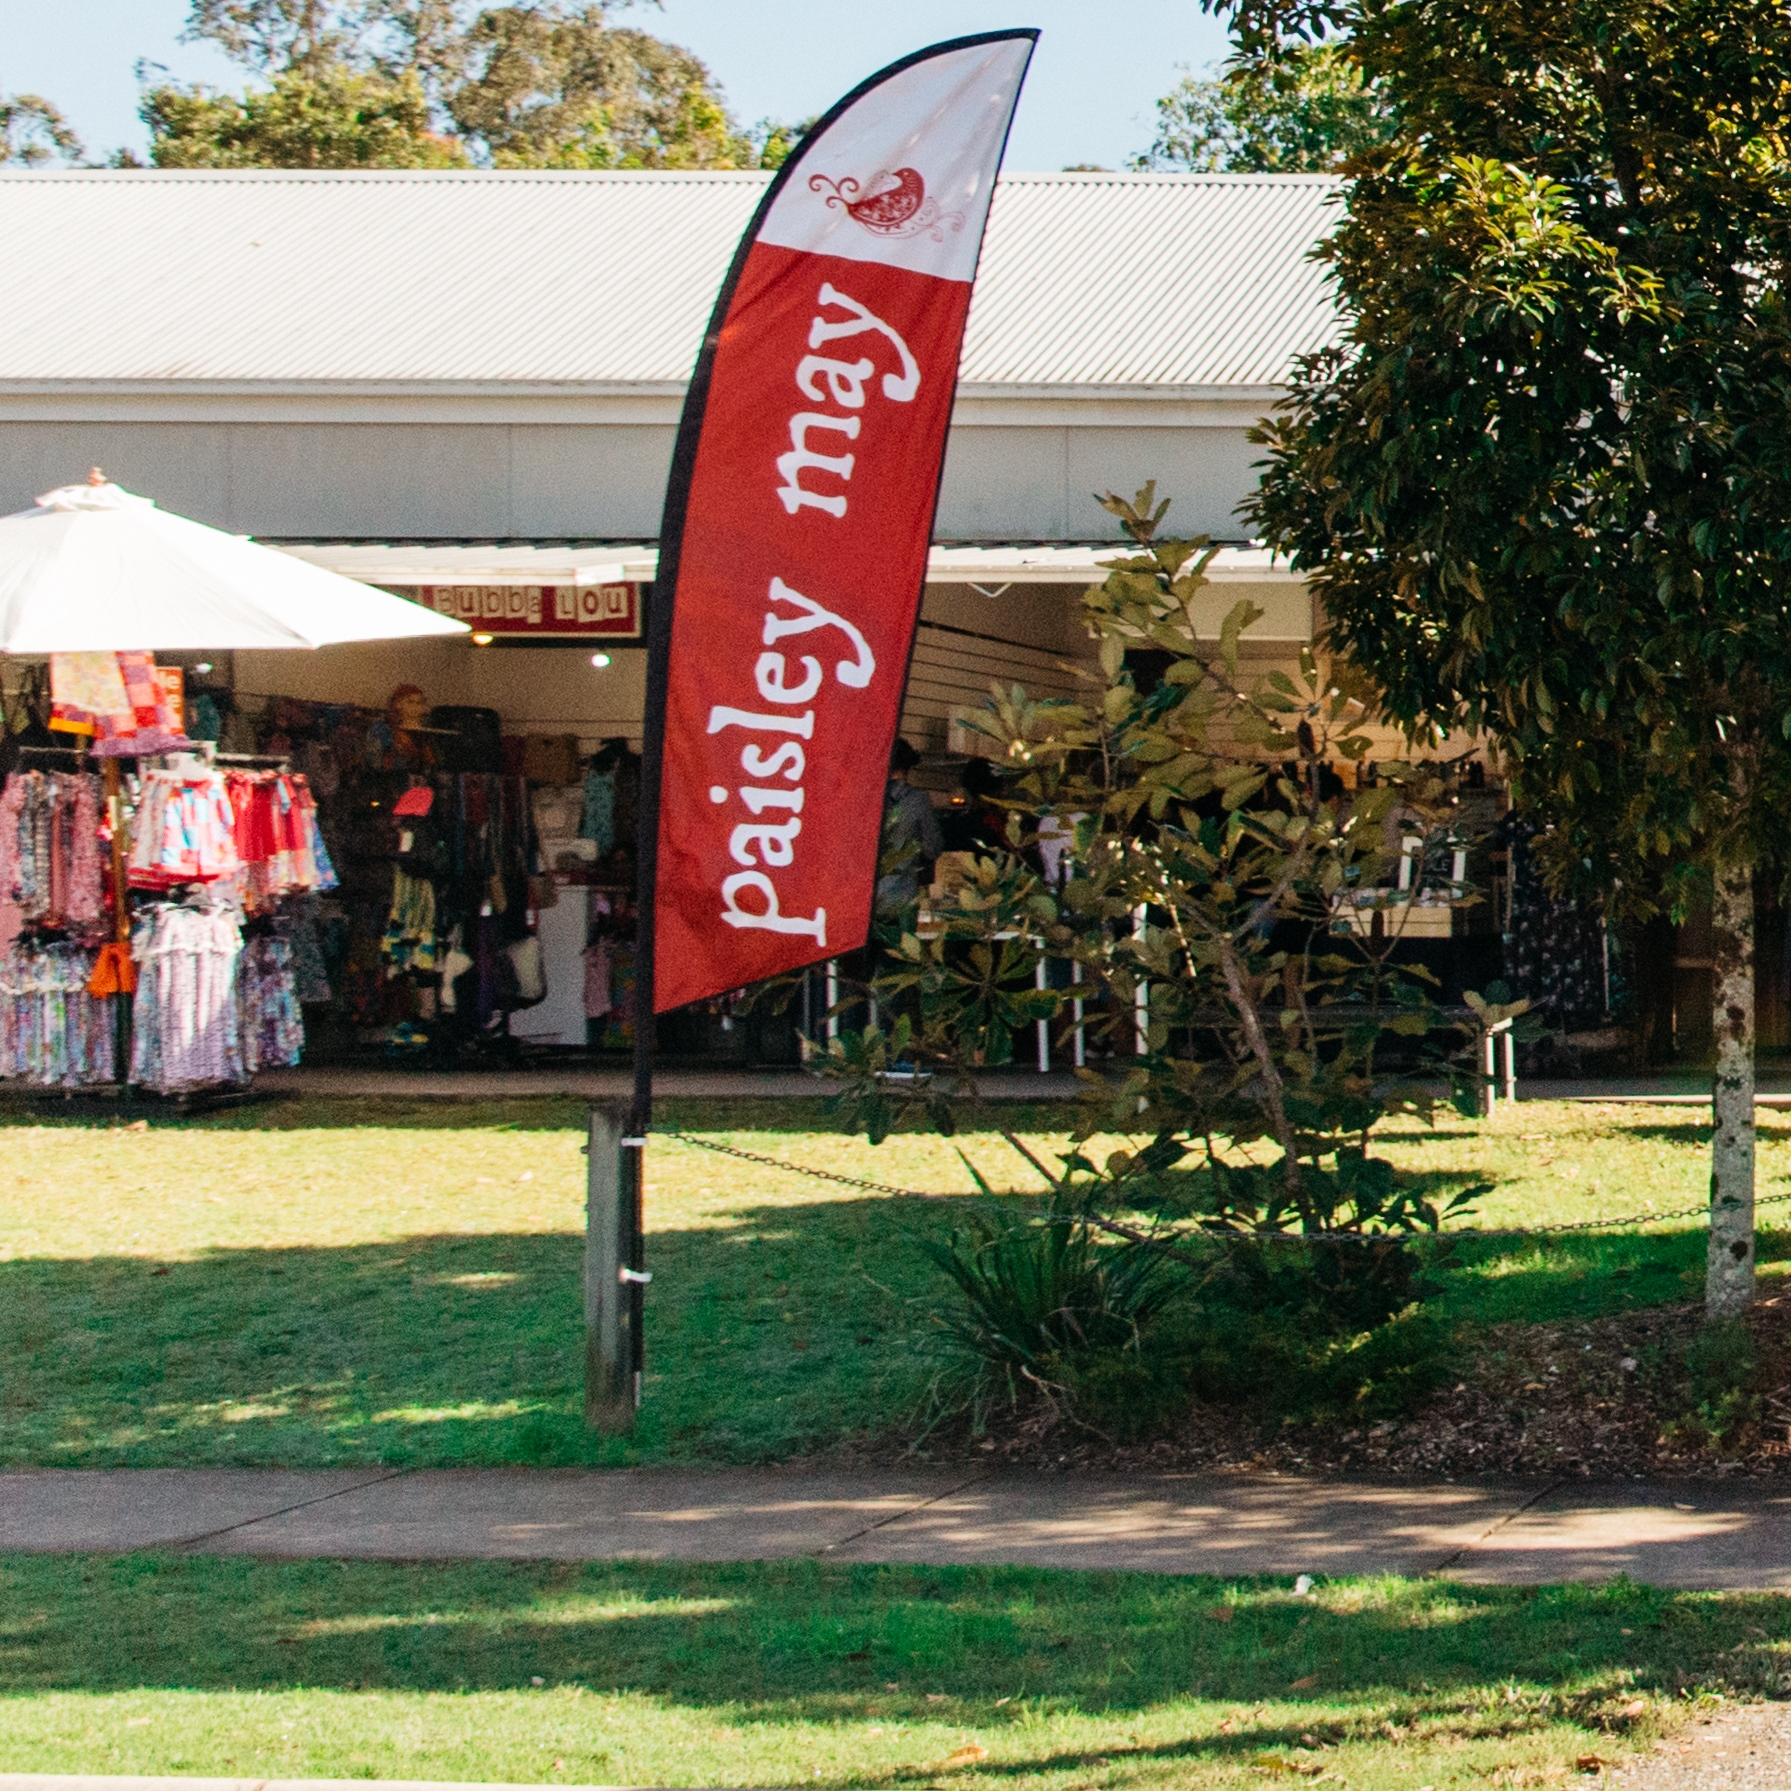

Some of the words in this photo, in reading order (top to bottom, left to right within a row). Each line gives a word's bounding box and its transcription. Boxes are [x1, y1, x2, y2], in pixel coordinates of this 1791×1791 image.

[775, 281, 922, 519] may
[437, 586, 541, 614] Bubba
[706, 575, 877, 948] paisley
